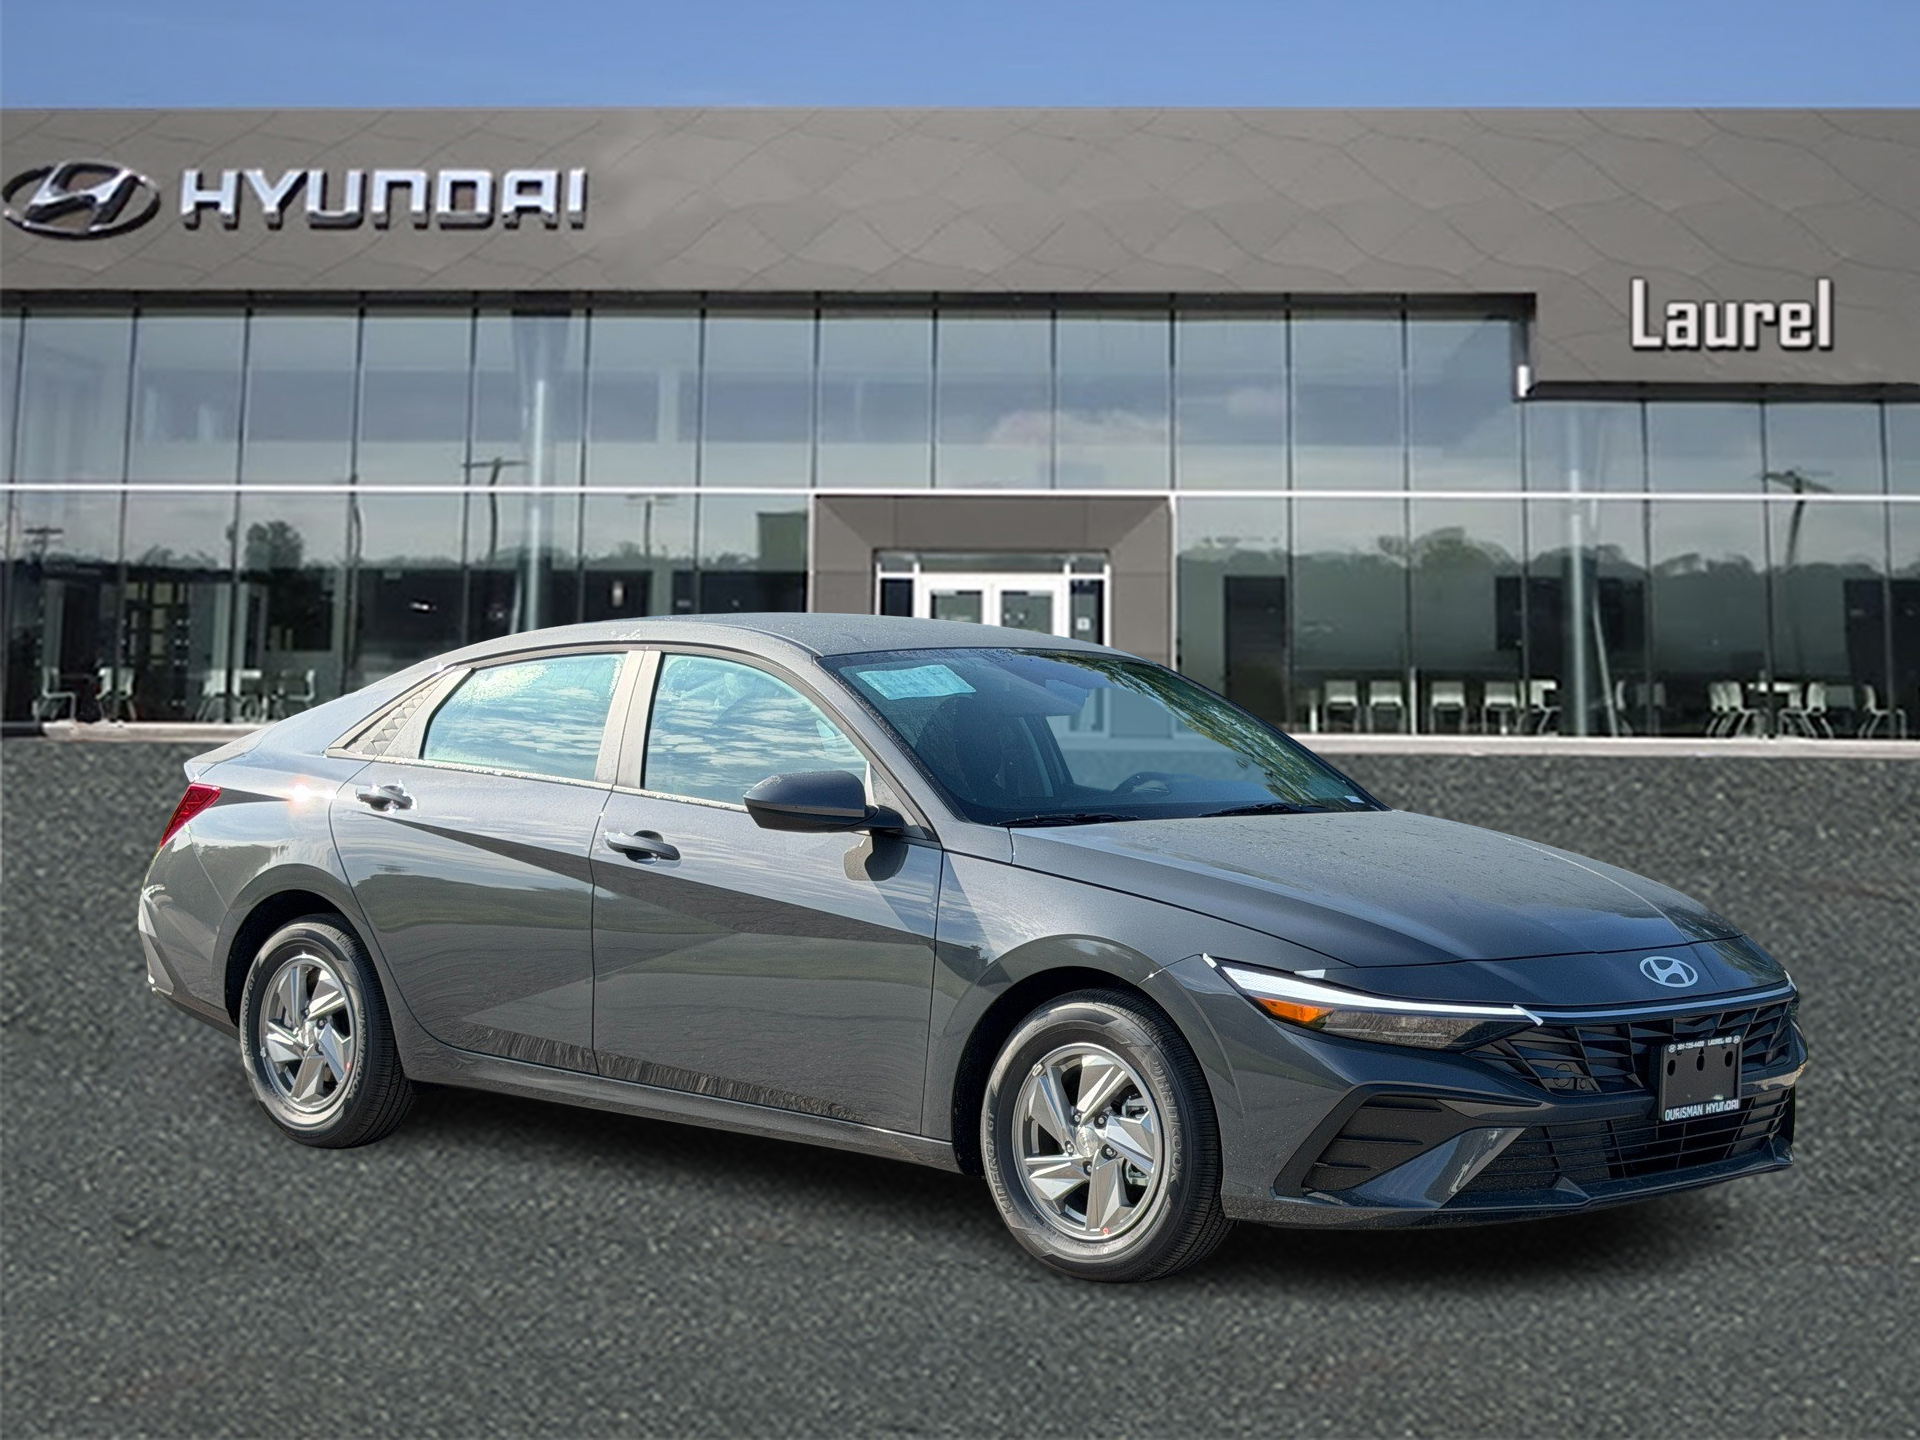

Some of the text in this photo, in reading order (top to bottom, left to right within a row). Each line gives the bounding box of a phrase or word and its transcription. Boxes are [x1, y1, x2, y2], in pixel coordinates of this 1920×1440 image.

[179, 168, 588, 229] HYUNDAI
[1631, 278, 1832, 349] Laurel
[1665, 1099, 1739, 1121] OURISMAN HYUNDAI
